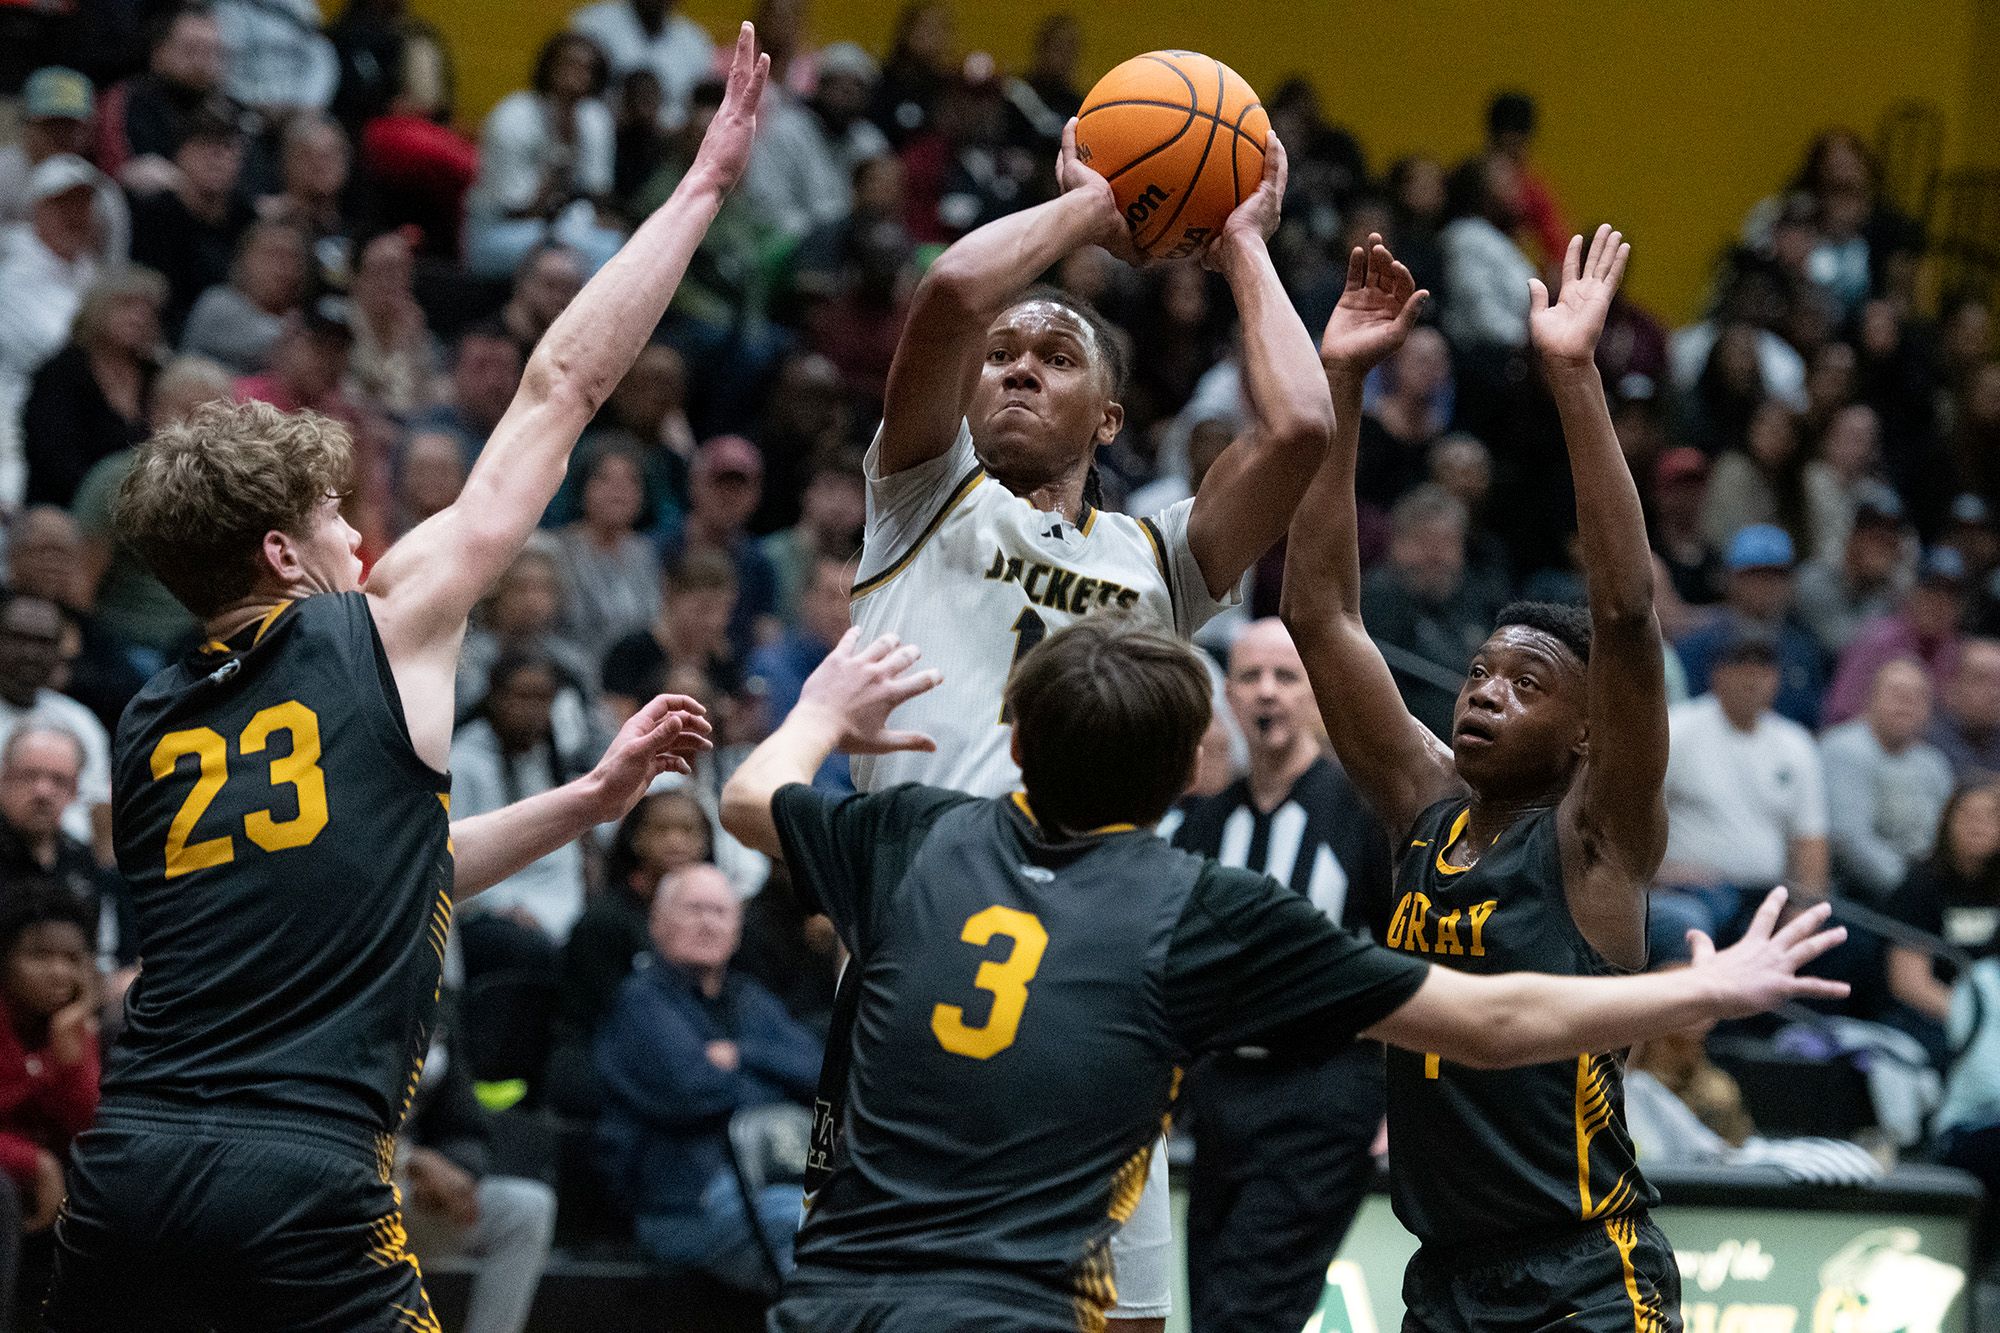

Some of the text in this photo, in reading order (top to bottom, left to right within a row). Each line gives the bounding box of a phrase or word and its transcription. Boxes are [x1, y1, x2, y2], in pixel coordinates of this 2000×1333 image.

[983, 545, 1141, 615] JACKETS
[149, 699, 330, 881] 23
[1386, 890, 1498, 957] GRAY
[930, 904, 1050, 1060] 3
